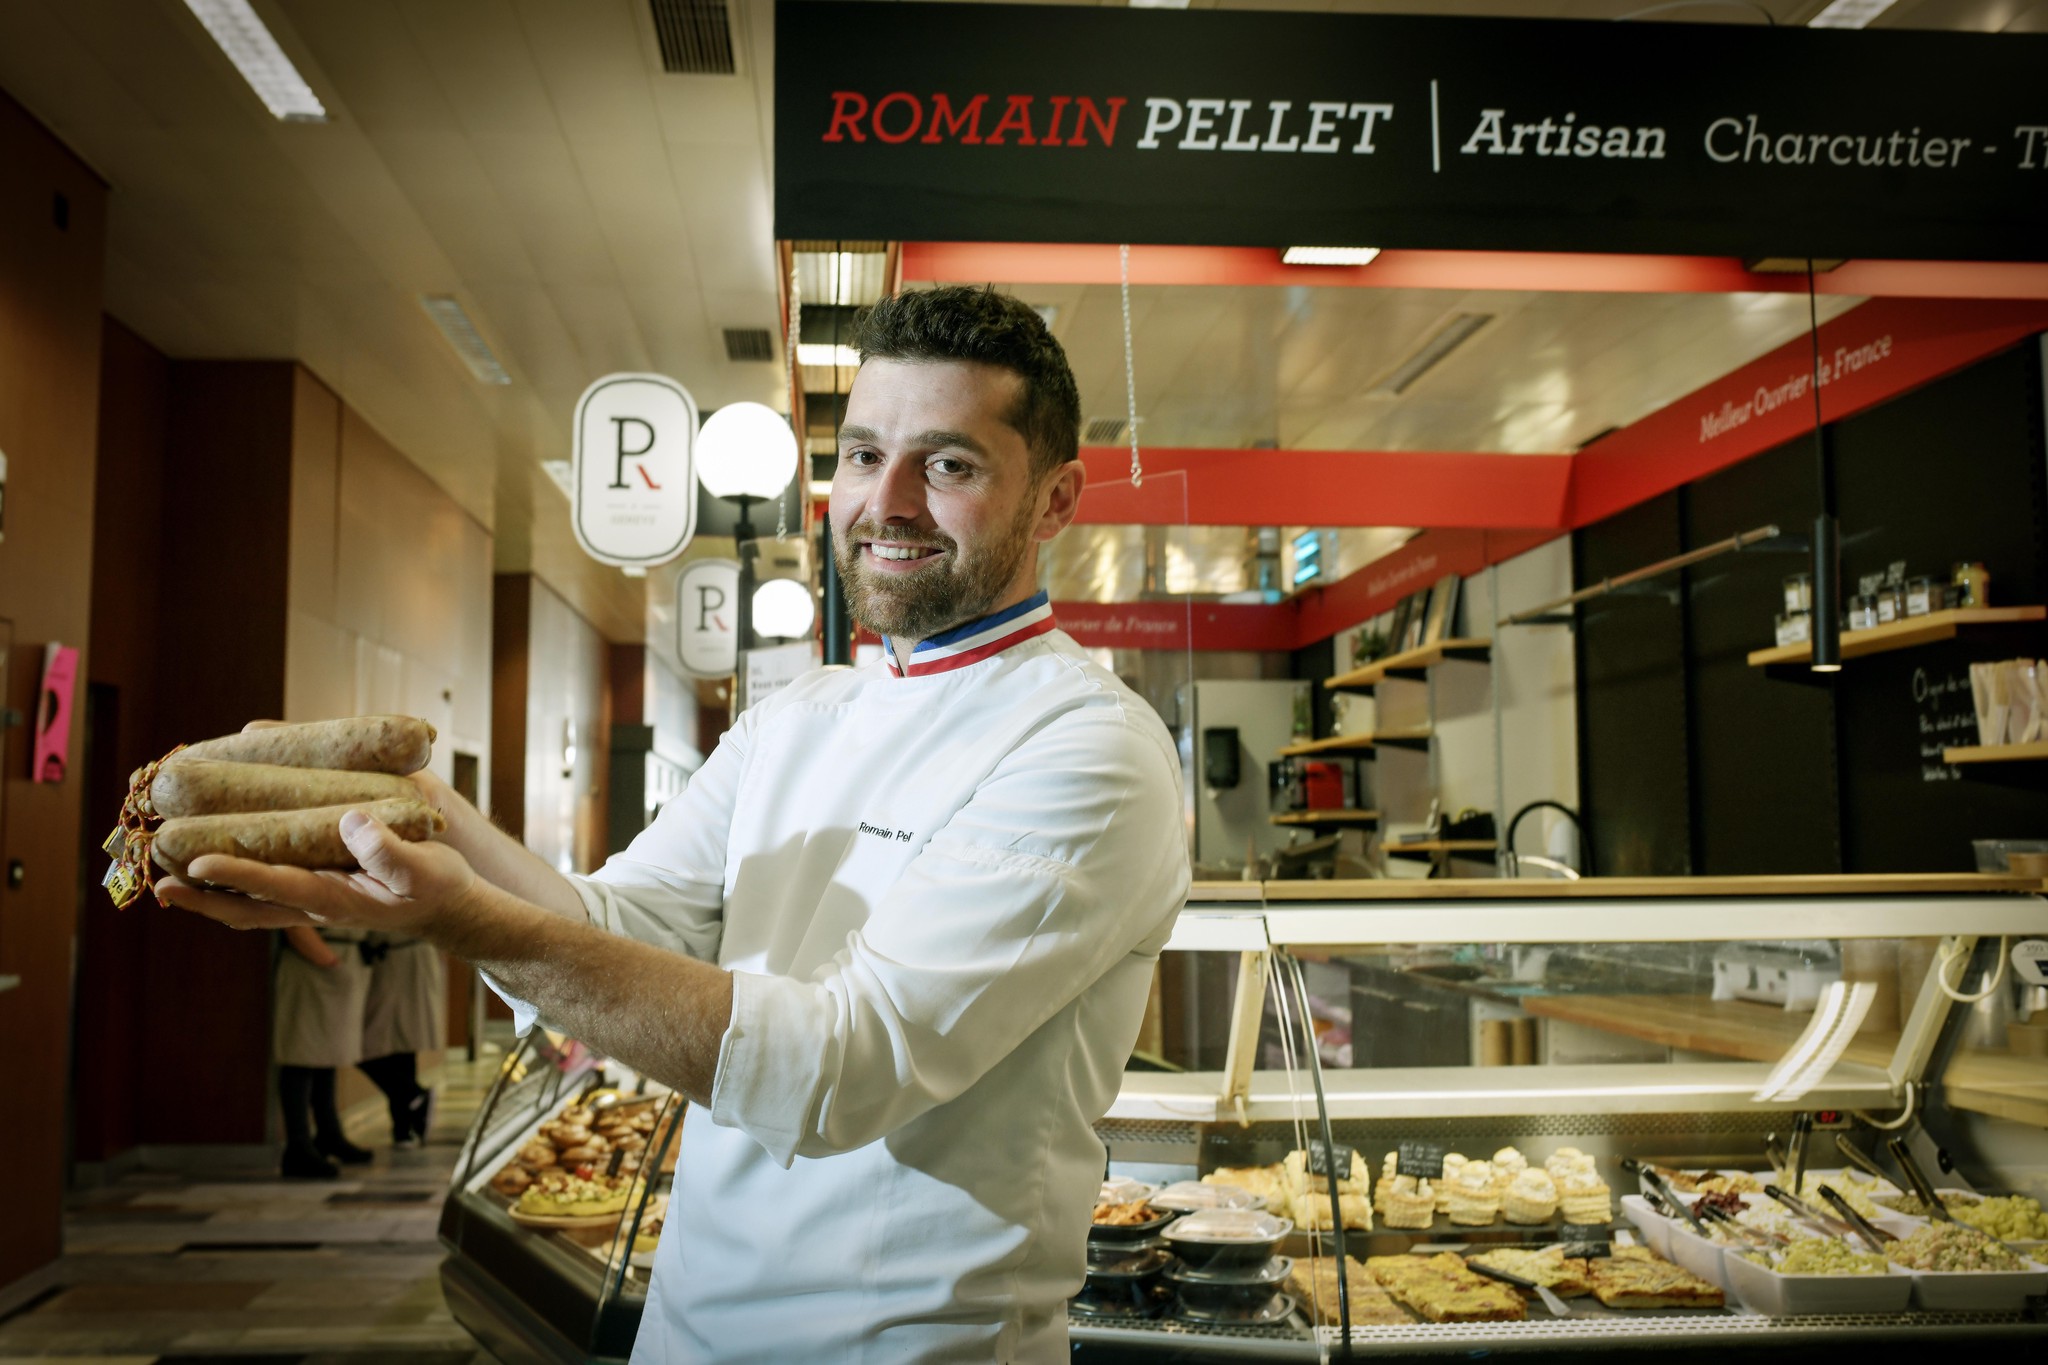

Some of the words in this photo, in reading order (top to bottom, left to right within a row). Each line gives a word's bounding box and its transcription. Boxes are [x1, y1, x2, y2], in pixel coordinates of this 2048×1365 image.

[822, 91, 1127, 148] ROMAIN
[1137, 97, 1394, 154] PELLET
[1461, 109, 1667, 160] Artisan
[1704, 115, 1972, 169] Charcutier
[1699, 402, 1752, 442] Meilleur
[1754, 374, 1810, 416] Ouvrier
[1833, 335, 1893, 379] France
[859, 821, 893, 840] Romain
